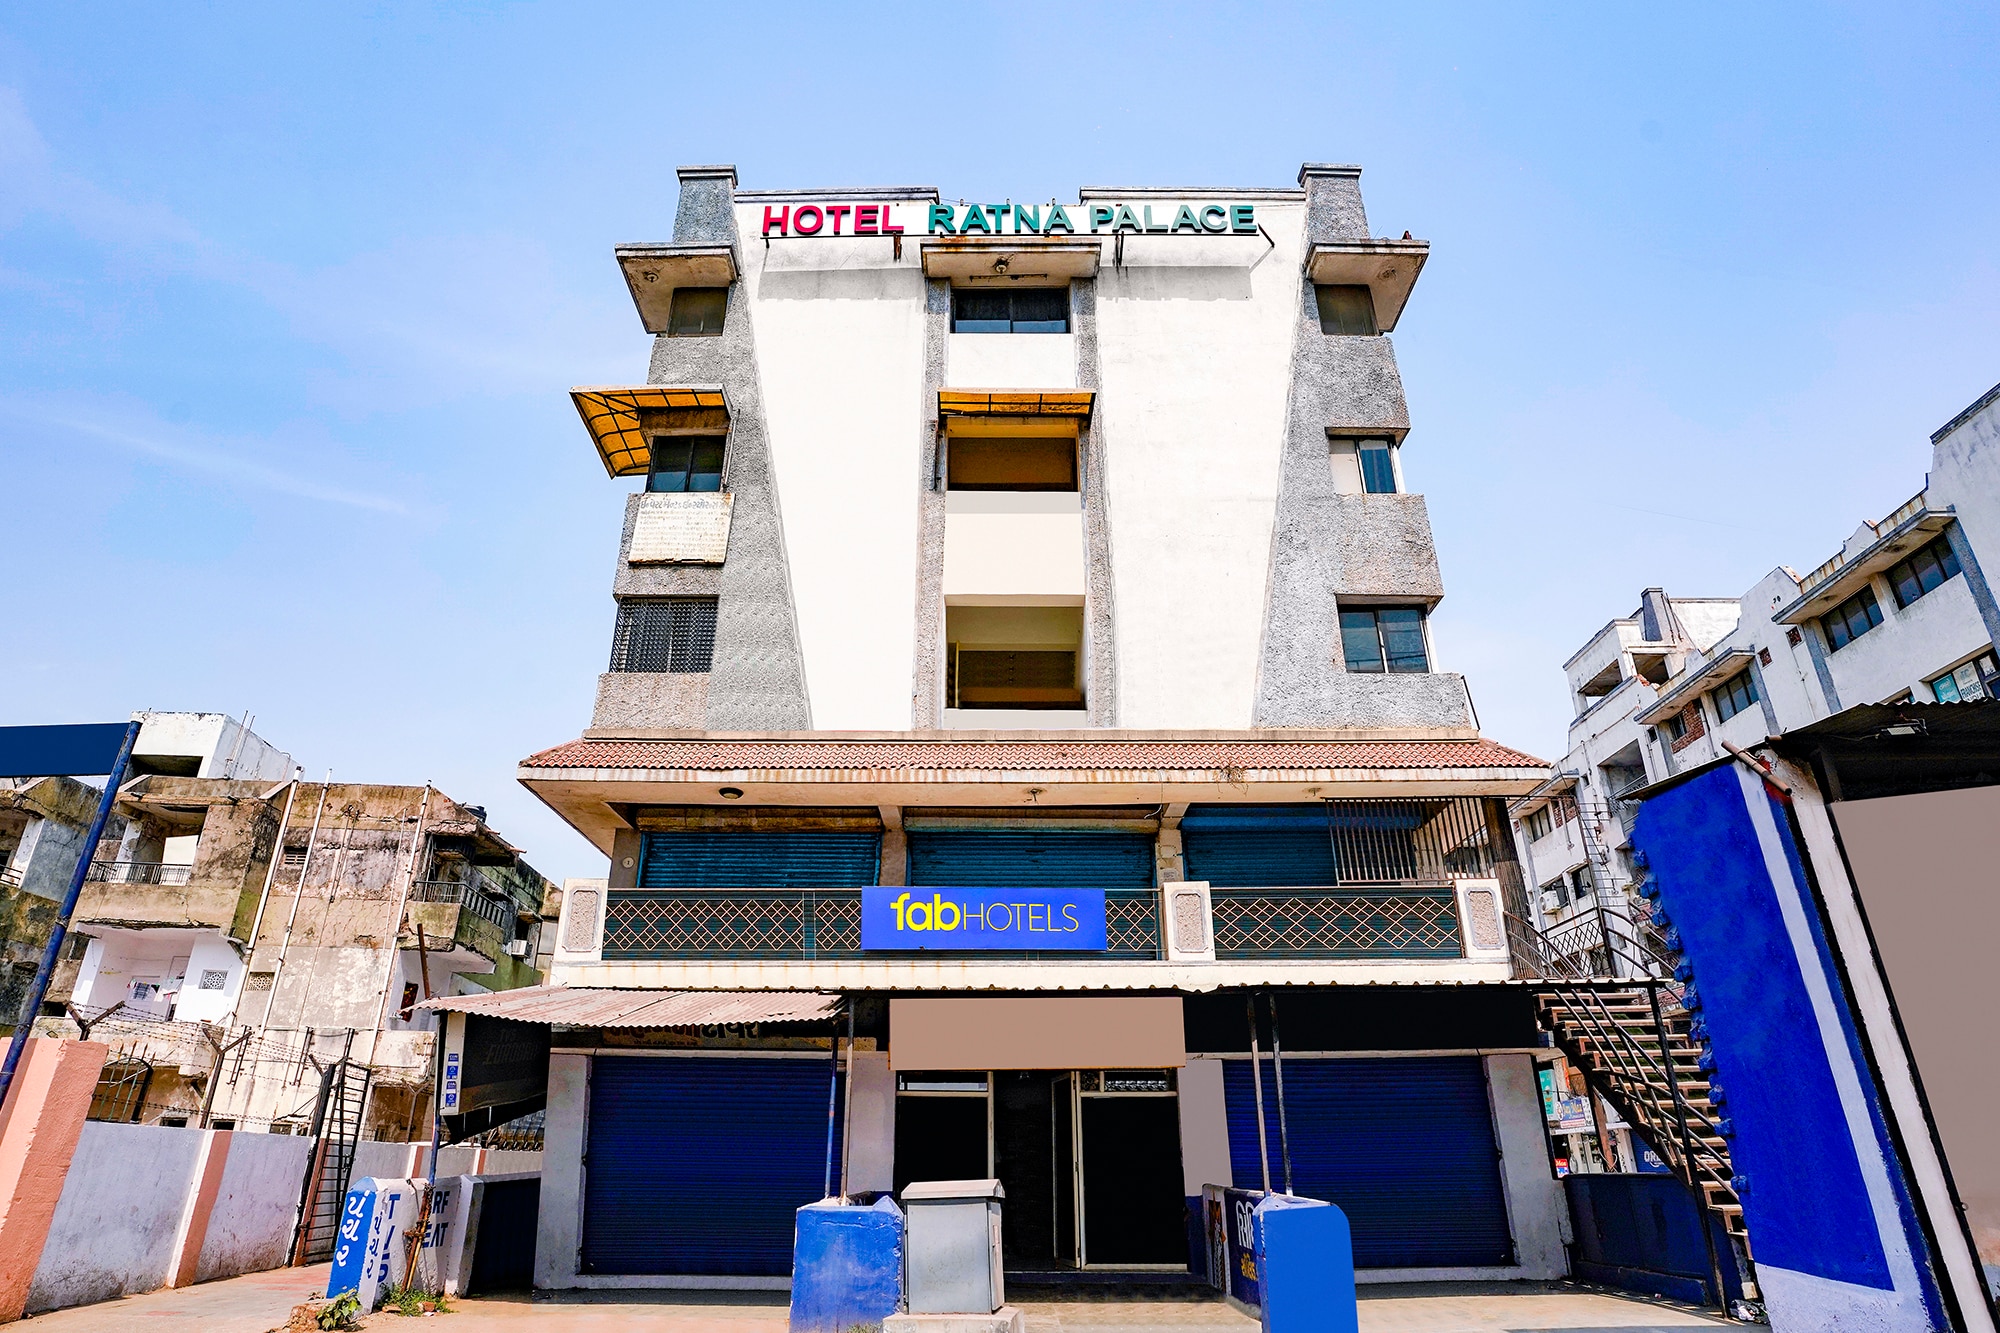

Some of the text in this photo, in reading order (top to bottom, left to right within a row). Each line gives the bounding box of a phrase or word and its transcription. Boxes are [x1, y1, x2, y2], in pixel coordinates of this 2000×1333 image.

[762, 204, 1258, 236] HOTEL RATNA PALACE
